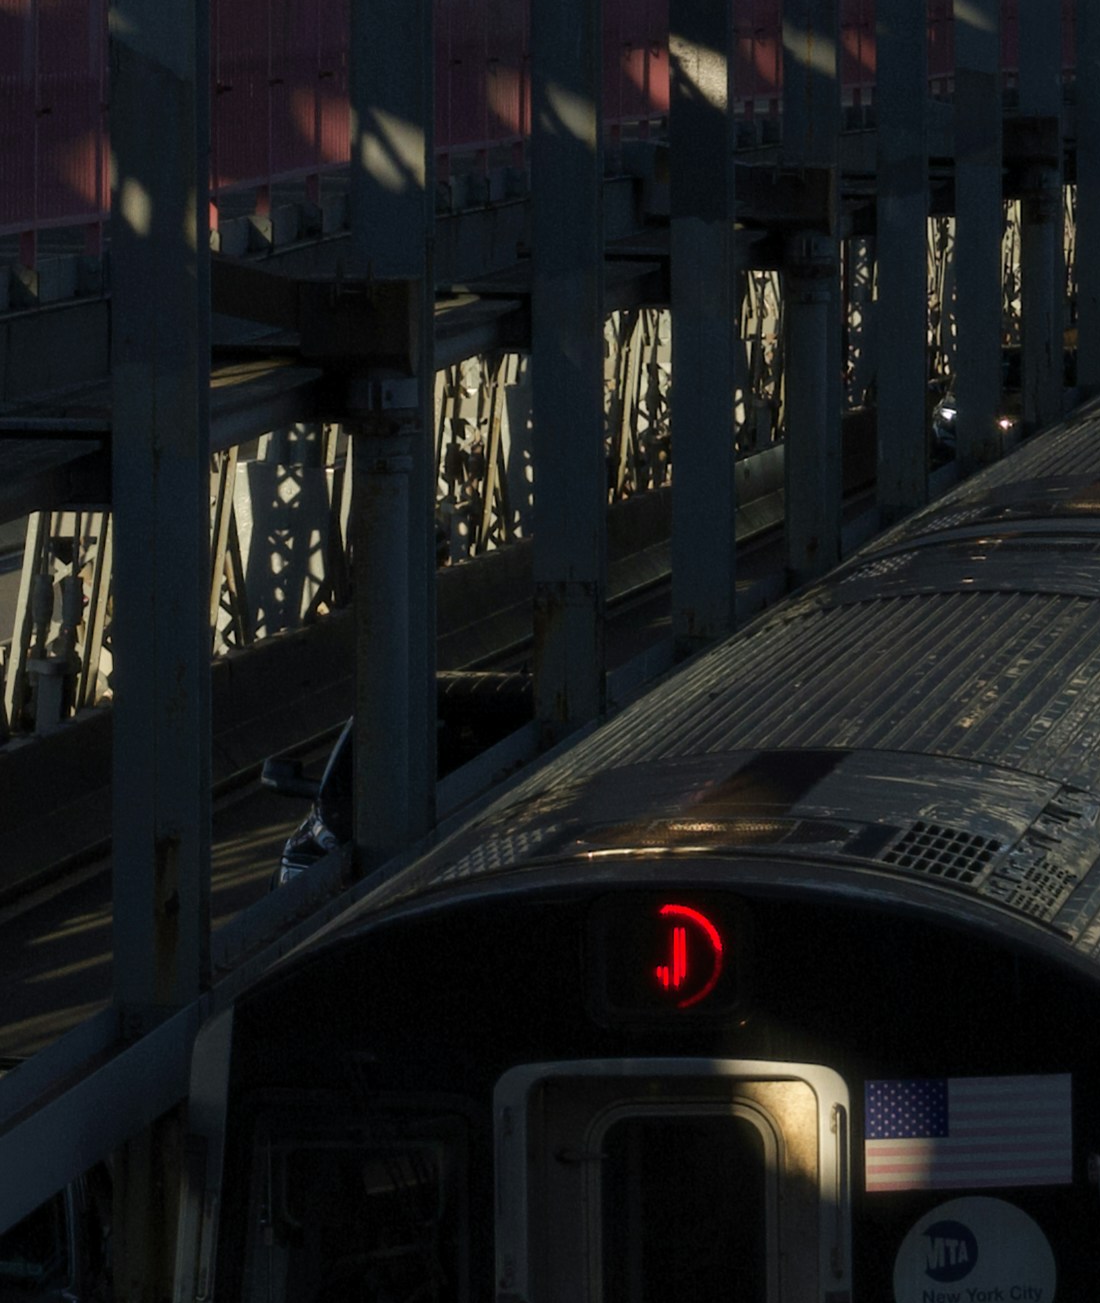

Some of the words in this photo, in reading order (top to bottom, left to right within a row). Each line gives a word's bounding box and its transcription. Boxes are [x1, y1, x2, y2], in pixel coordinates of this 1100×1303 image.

[926, 1236, 970, 1270] MTA
[966, 1286, 1005, 1303] York
[1009, 1285, 1043, 1303] City
